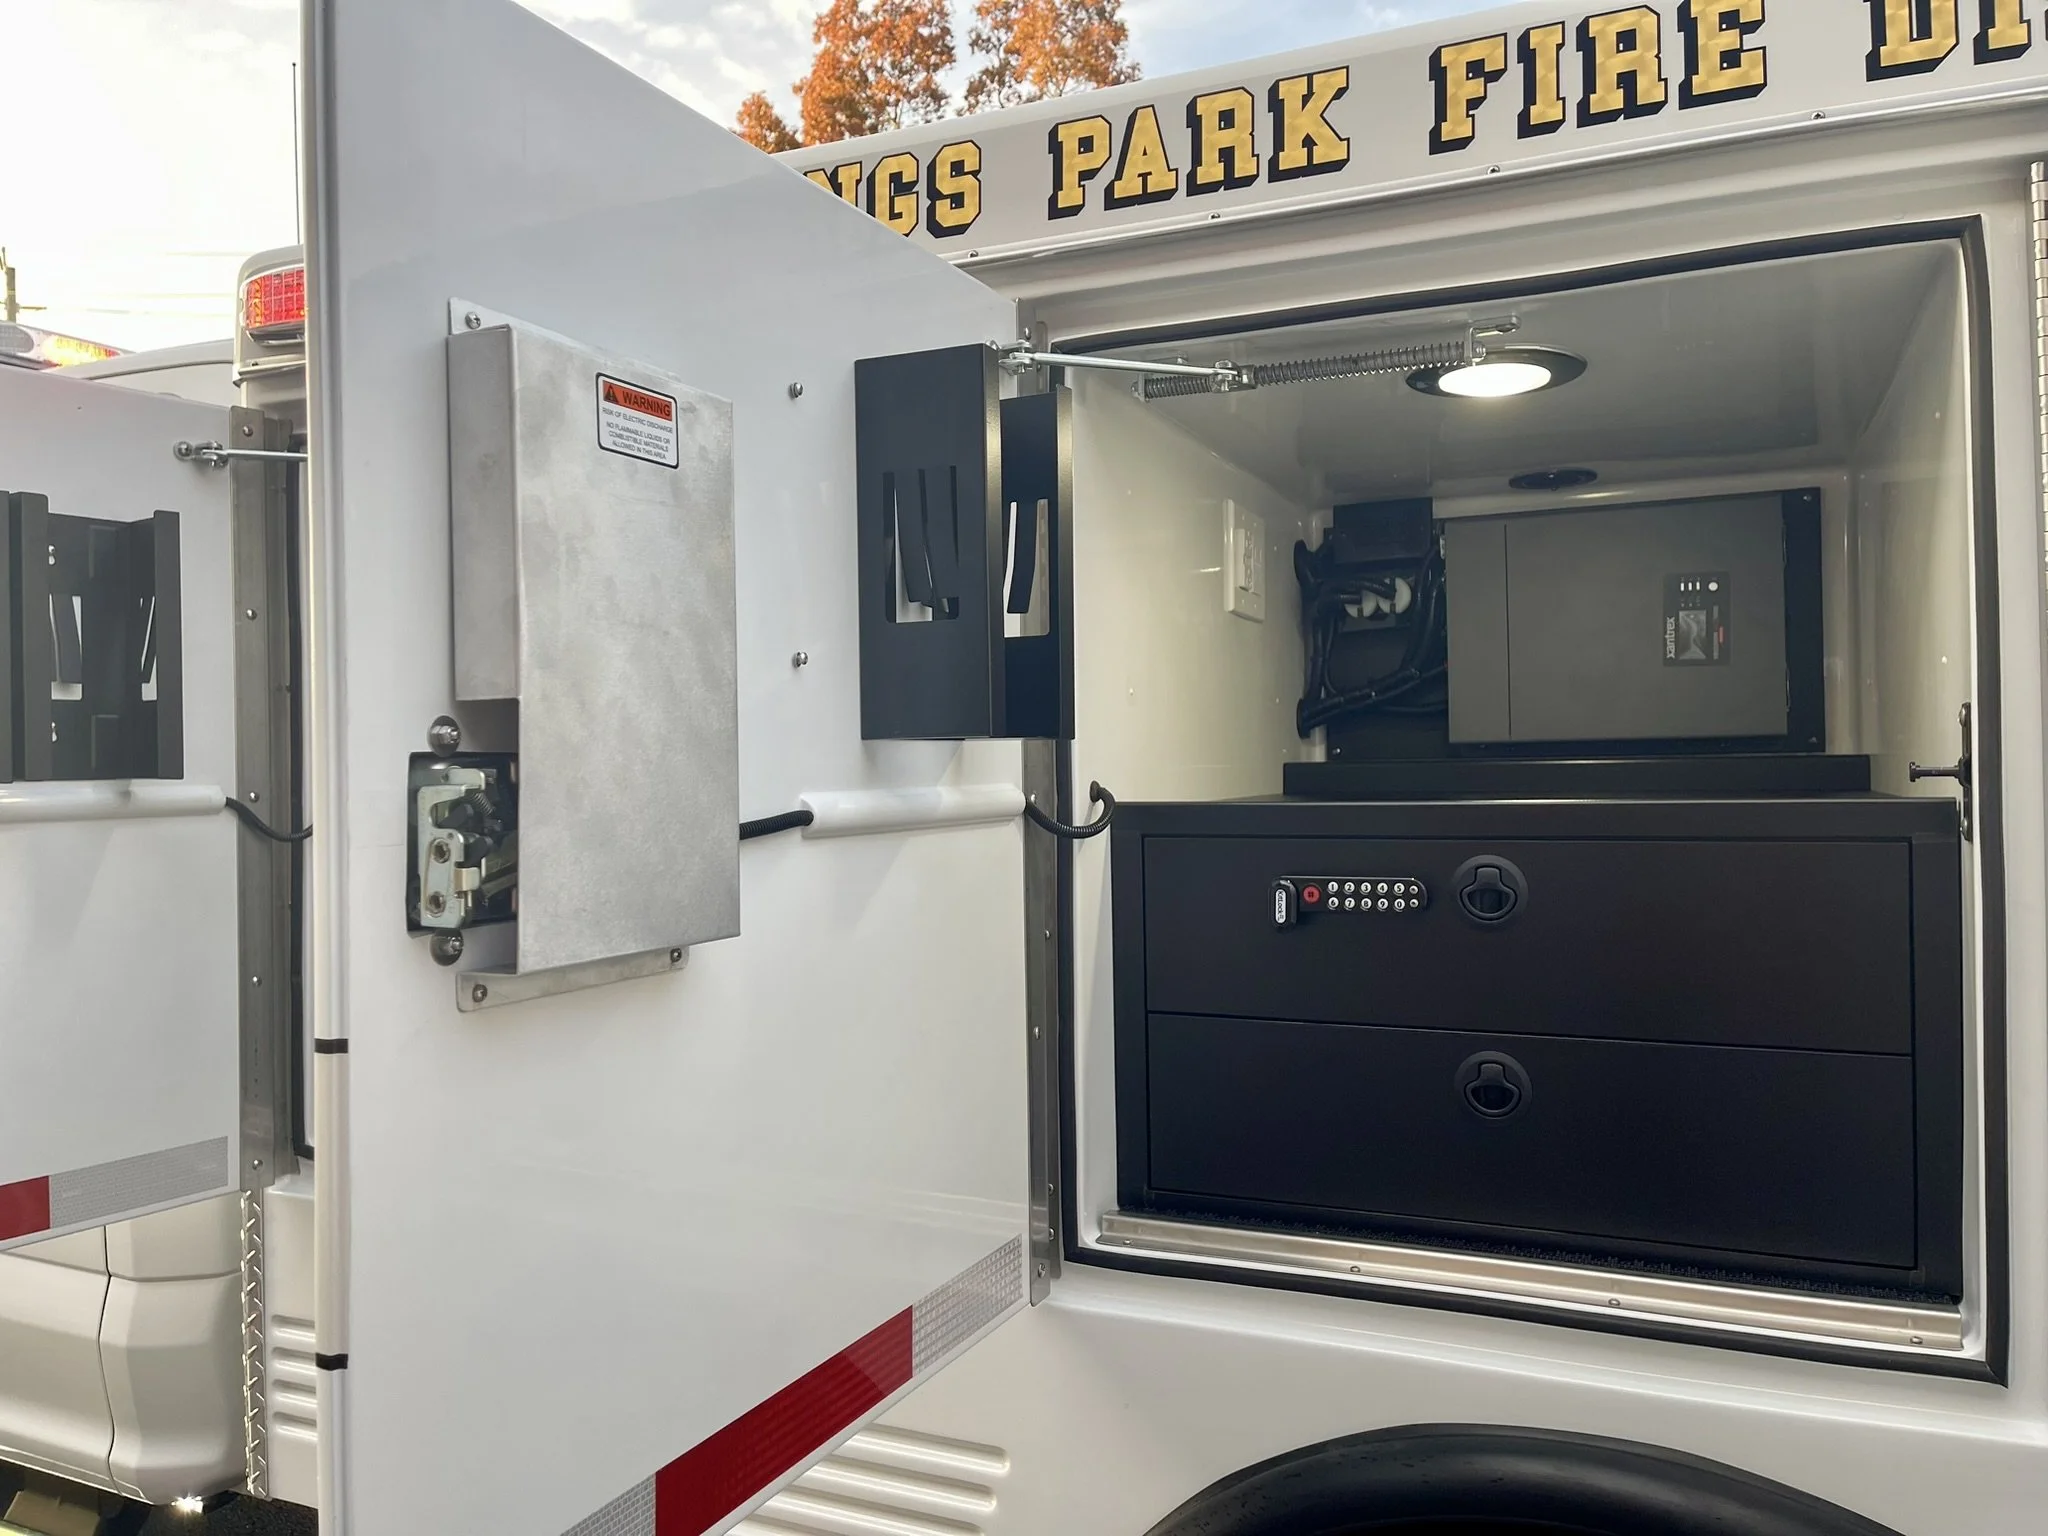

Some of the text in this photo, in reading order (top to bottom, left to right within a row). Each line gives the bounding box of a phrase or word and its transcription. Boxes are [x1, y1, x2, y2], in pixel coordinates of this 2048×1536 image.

[1048, 65, 1351, 220] PARK
[1429, 0, 1767, 155] FIRE
[622, 390, 672, 417] WARNING
[602, 407, 673, 434] RISK OF ELECTRIC DISCHARGE
[615, 423, 643, 438] FLAMMABLE
[608, 430, 669, 453] COMBUSTIBLE MATERIALS
[612, 440, 636, 452] ALLOWED
[642, 448, 653, 456] THIS
[653, 451, 667, 460] AREA
[1665, 616, 1675, 658] xantrex
